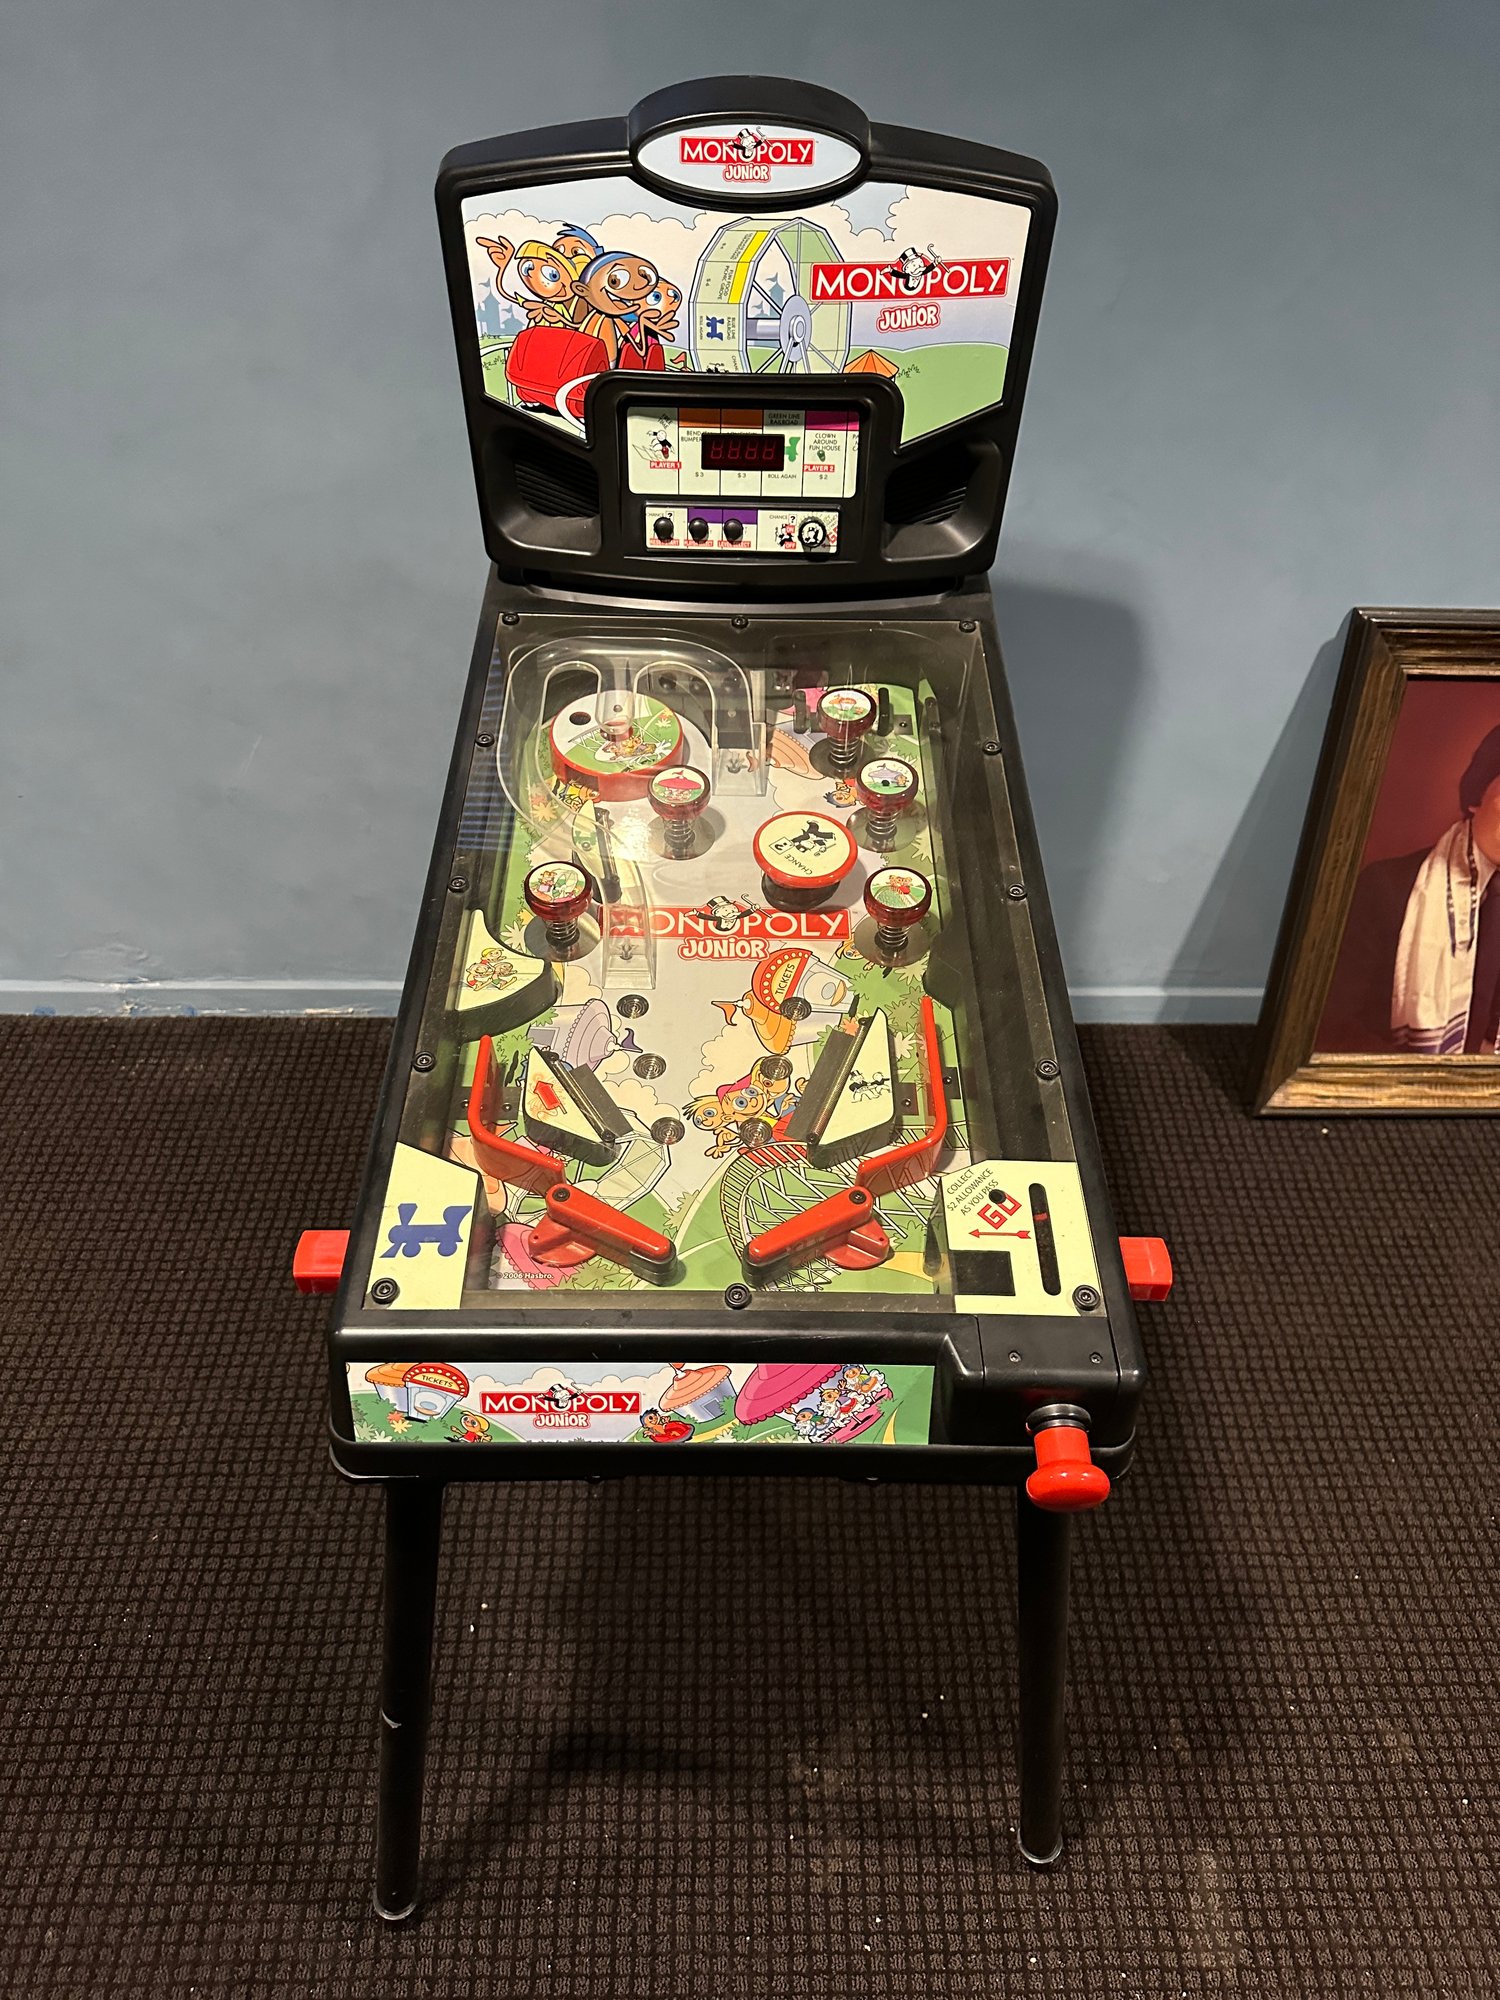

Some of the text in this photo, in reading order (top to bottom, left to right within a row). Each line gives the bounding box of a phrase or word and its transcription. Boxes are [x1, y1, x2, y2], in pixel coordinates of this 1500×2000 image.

[683, 140, 812, 163] MONOPOLY
[815, 264, 1005, 297] MONOPOLY
[650, 461, 675, 469] PLAYER
[803, 464, 828, 472] PLAYER
[784, 853, 813, 876] CHANCE
[774, 963, 796, 996] TICKETS
[946, 1168, 975, 1195] COLLECT
[956, 1167, 994, 1204] ALLOWANCE
[960, 1178, 1000, 1216] AS YOU PASS
[502, 1272, 524, 1280] 2006
[524, 1272, 554, 1280] Hasbro.
[421, 1374, 454, 1388] TICKETS
[484, 1394, 637, 1412] MONOPOLY
